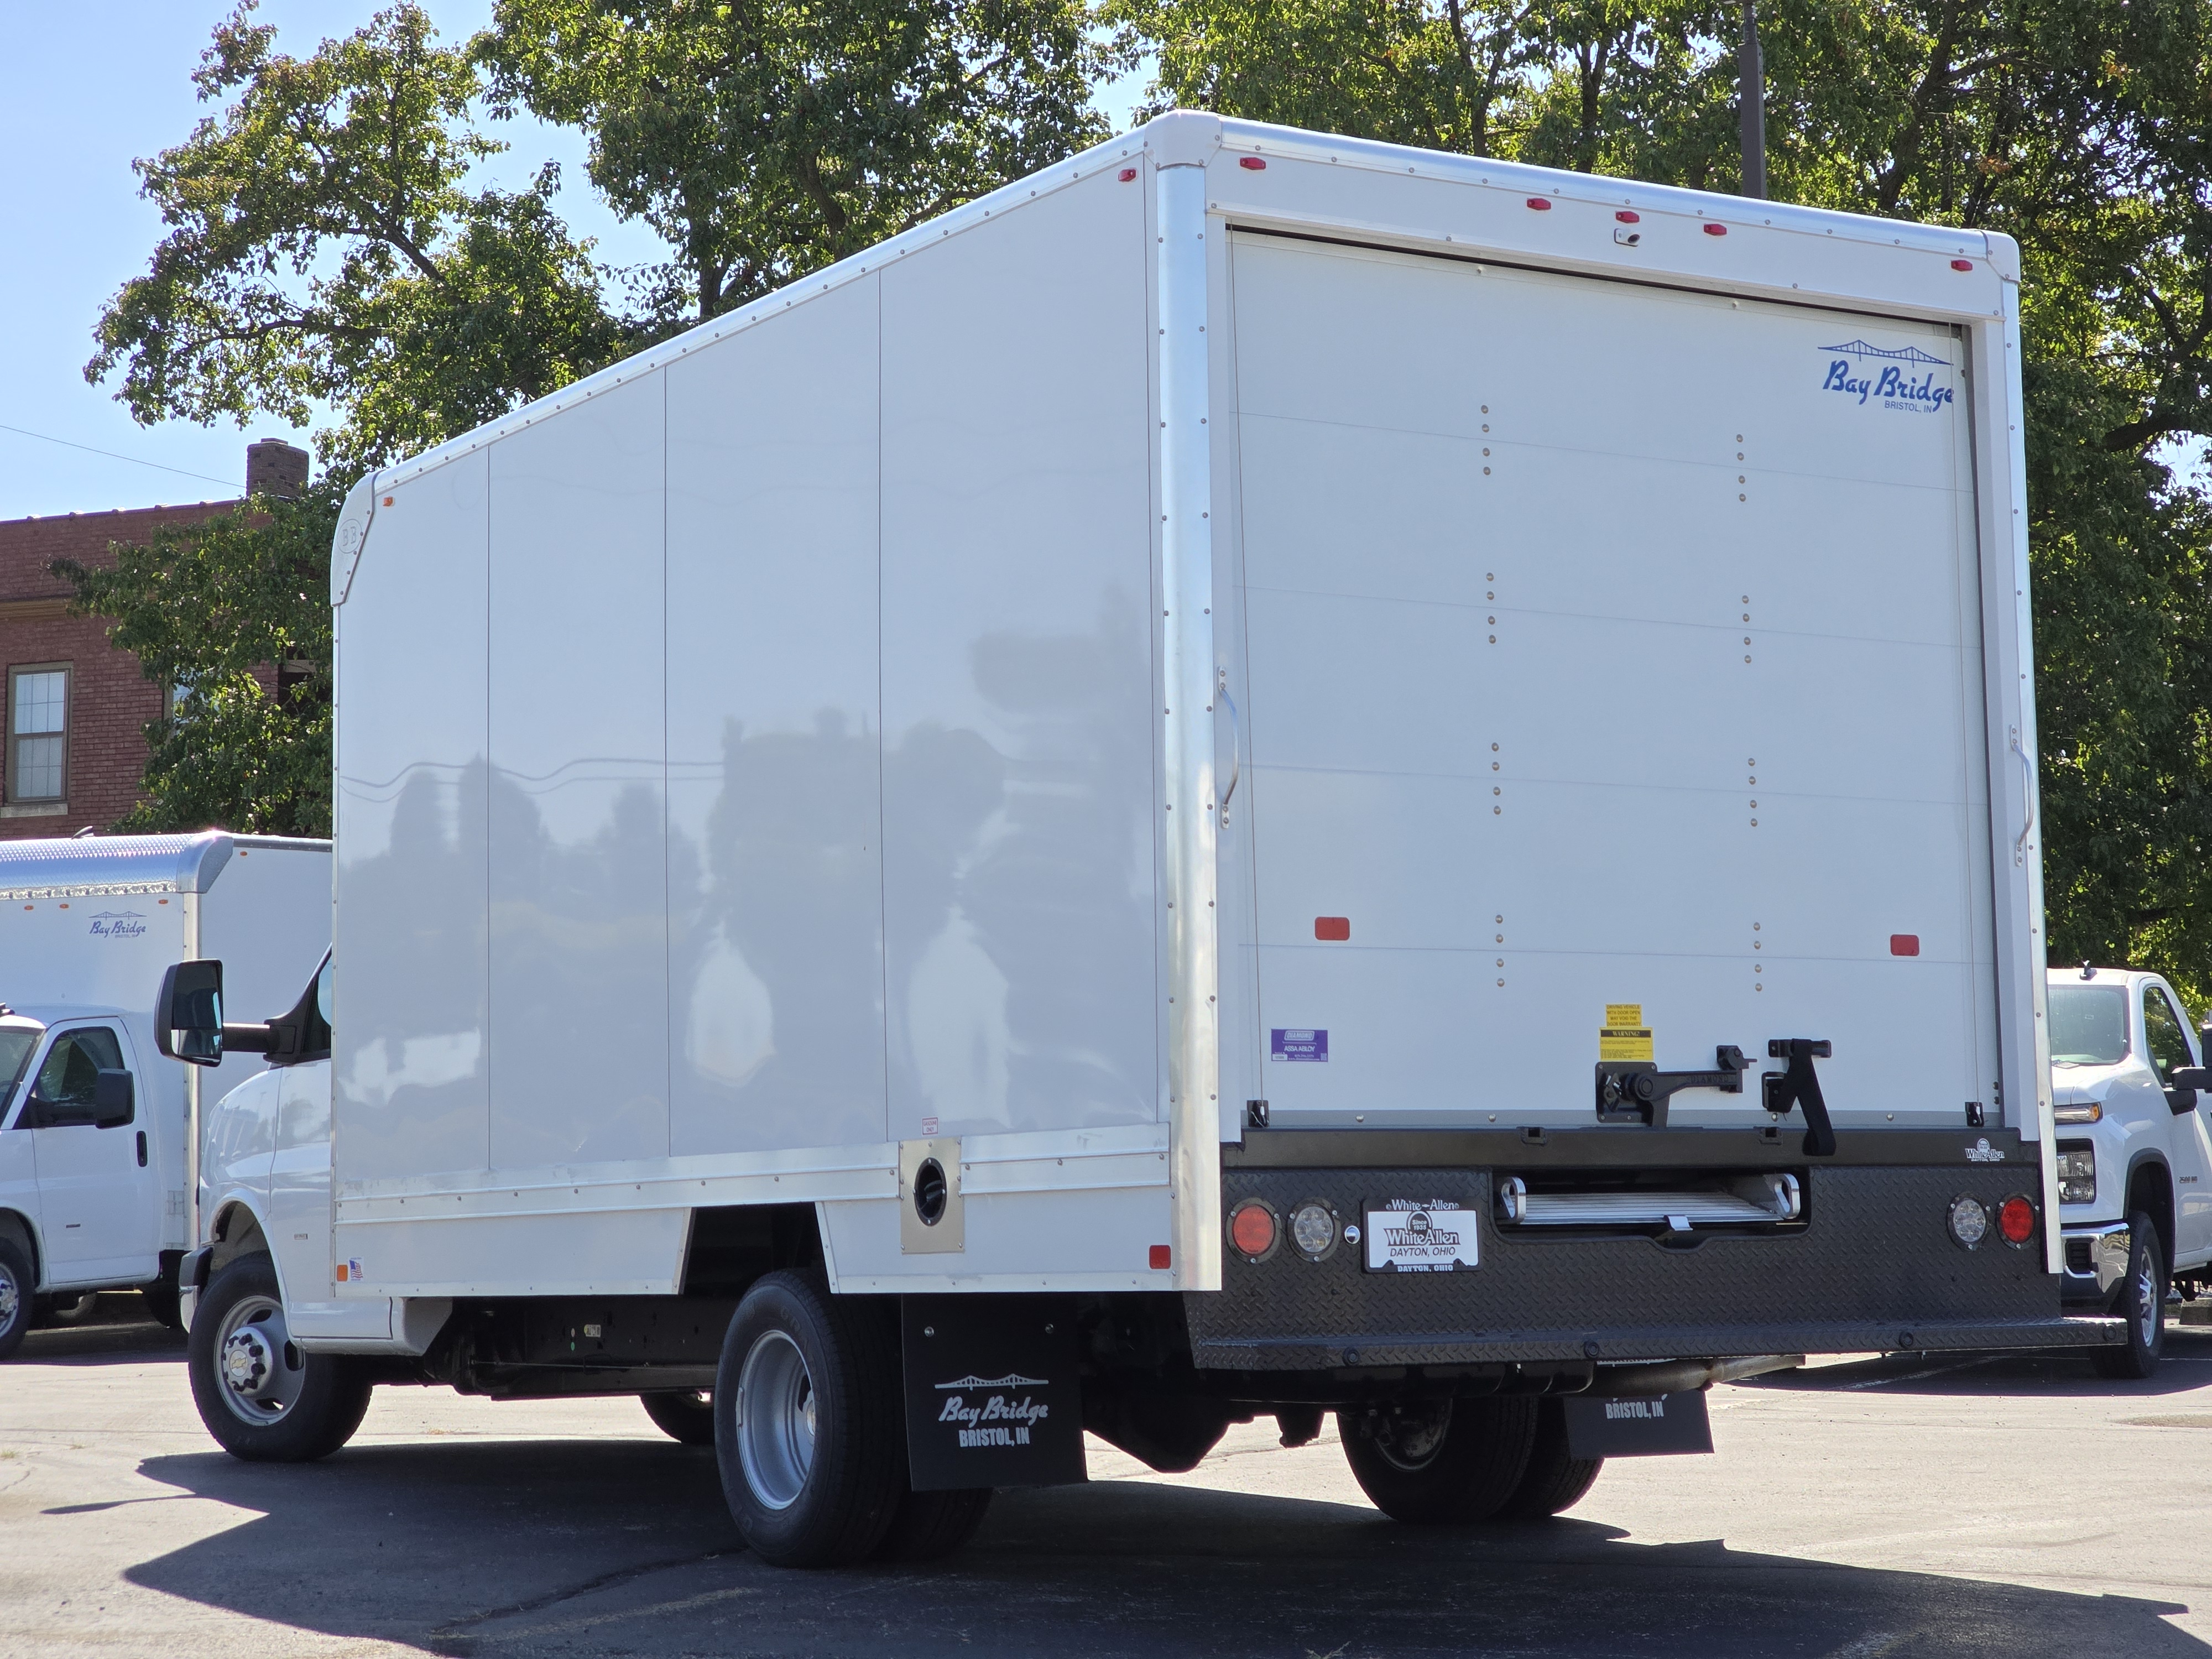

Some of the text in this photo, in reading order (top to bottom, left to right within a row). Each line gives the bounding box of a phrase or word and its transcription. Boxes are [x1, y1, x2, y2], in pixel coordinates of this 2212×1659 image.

[1823, 359, 1954, 413] Bay Bridge
[1885, 400, 1932, 413] BRISTOL, IN
[90, 920, 146, 938] Bay Bridge
[1390, 1246, 1455, 1258] DAYTON, OHIO
[938, 1395, 1048, 1428] Bay Bridge
[1605, 1401, 1664, 1419] BRISTOL, IN
[959, 1427, 1030, 1447] BRISTOL, IN
